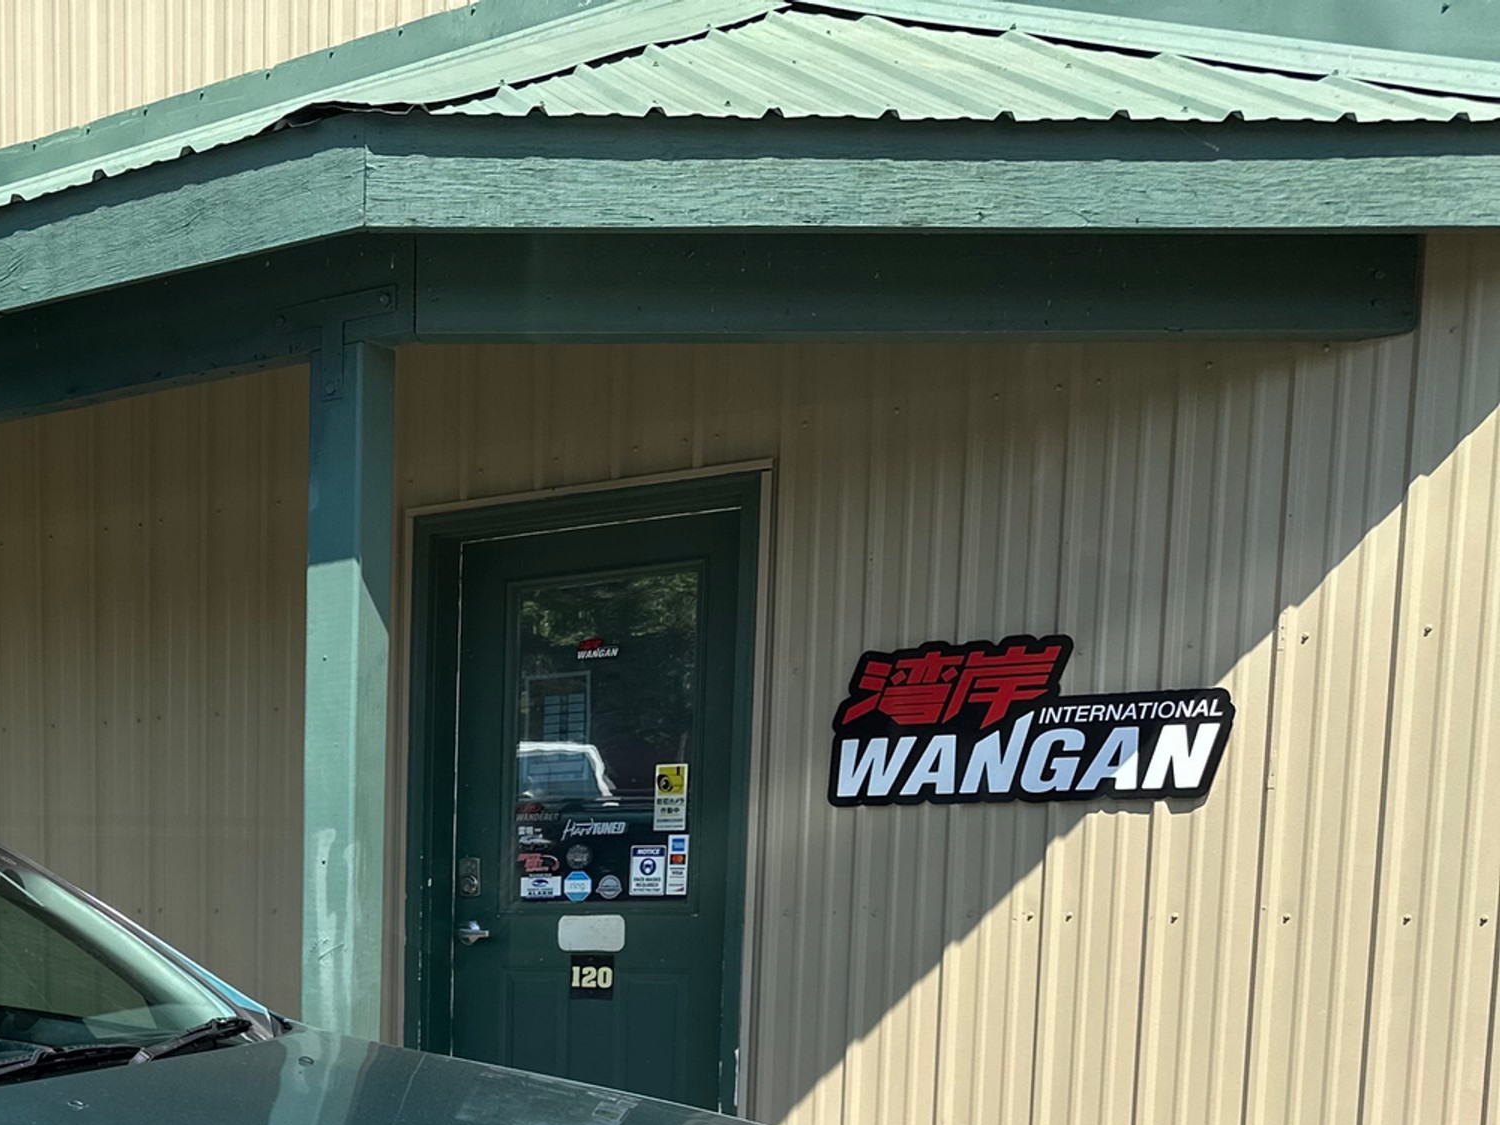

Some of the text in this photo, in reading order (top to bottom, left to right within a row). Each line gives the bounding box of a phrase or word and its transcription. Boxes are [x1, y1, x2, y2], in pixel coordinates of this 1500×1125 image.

[577, 647, 619, 659] WANGAN
[842, 645, 1062, 729] 湾岸
[1039, 699, 1223, 725] INTERNATIONAL
[837, 711, 1220, 798] WANGAN
[571, 966, 613, 988] 120
